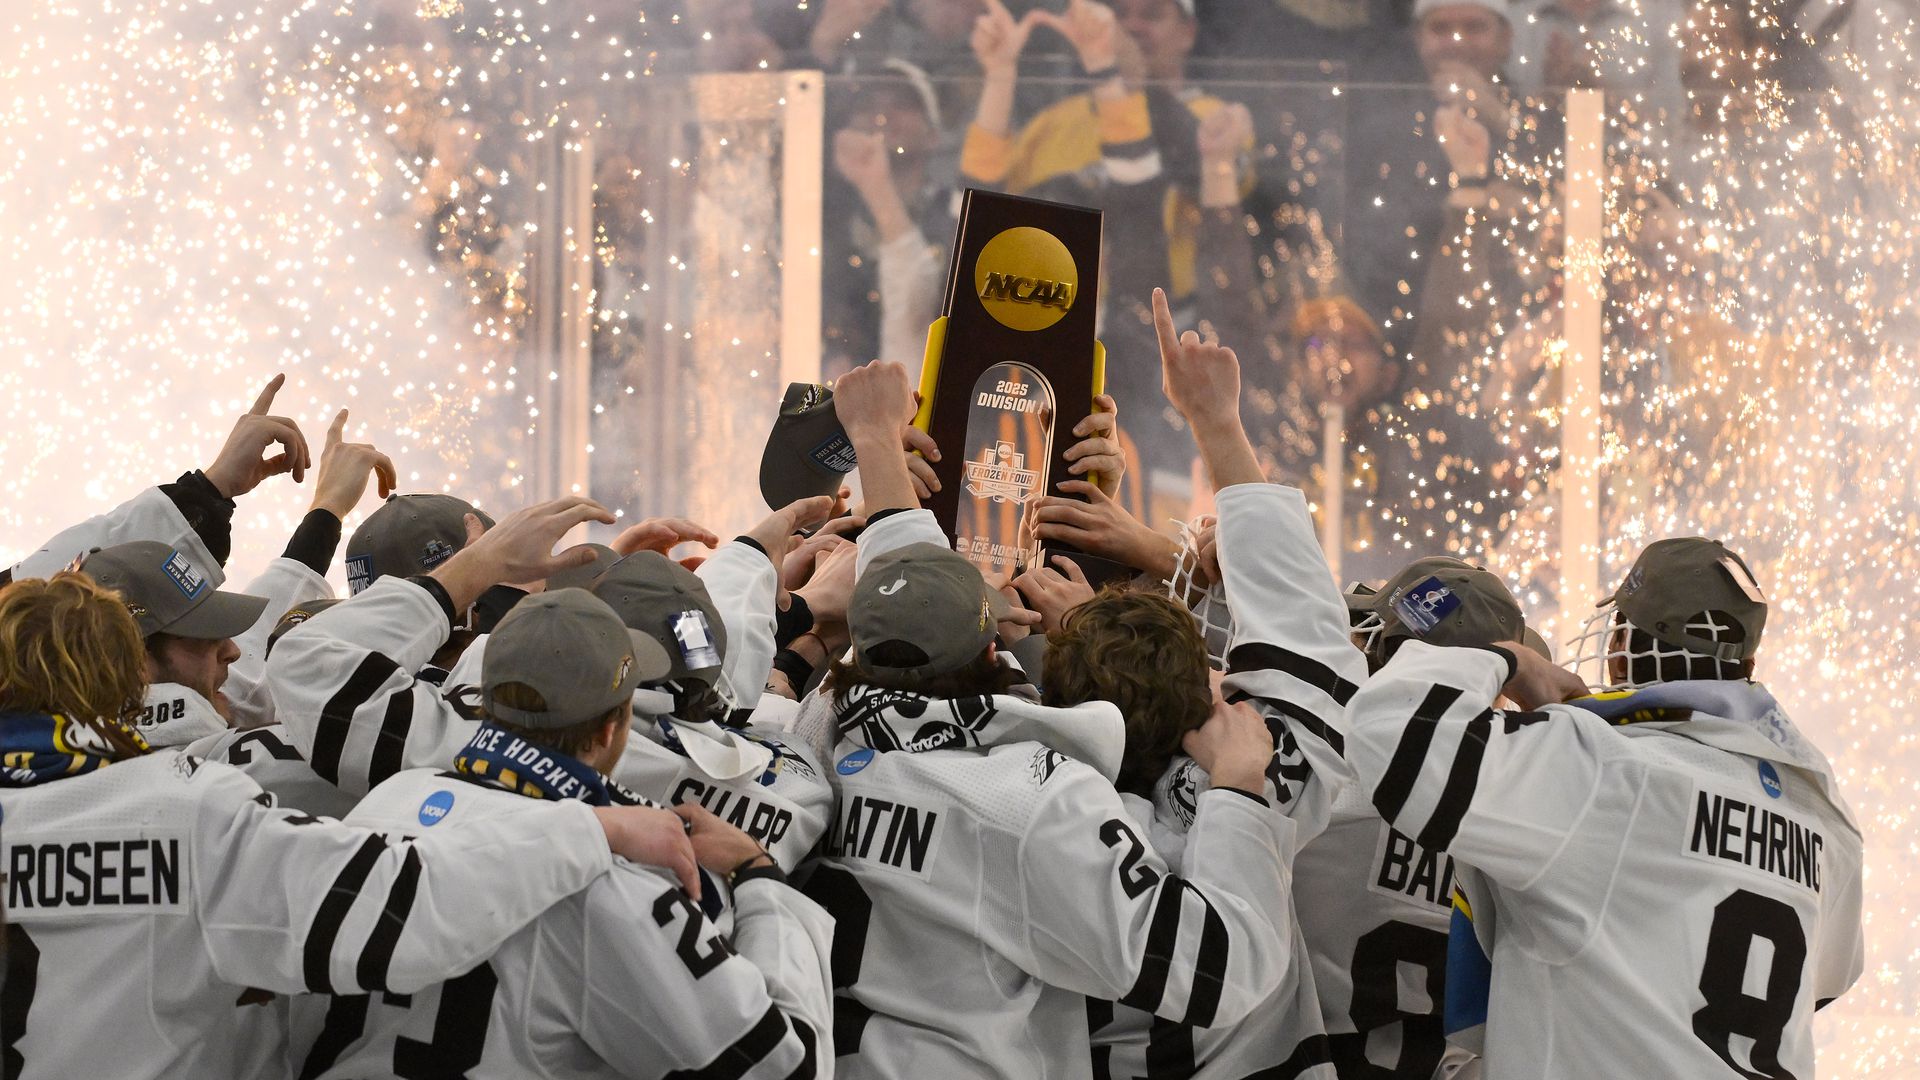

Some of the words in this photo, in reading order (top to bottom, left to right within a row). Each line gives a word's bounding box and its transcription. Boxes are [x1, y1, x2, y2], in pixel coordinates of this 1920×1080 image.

[980, 271, 1073, 311] NCAA
[996, 380, 1029, 396] 2025
[977, 392, 1036, 413] DIVISION
[971, 466, 1008, 481] FROZEN
[1009, 472, 1033, 485] FOUR
[968, 552, 1024, 568] CHAMPIONSHIP
[971, 541, 989, 554] ICE
[990, 544, 1030, 560] HOCKEY
[471, 728, 505, 752] ICE
[502, 738, 593, 801] HOCKEY
[1691, 790, 1823, 894] NEHRING
[1692, 888, 1807, 1080] 8
